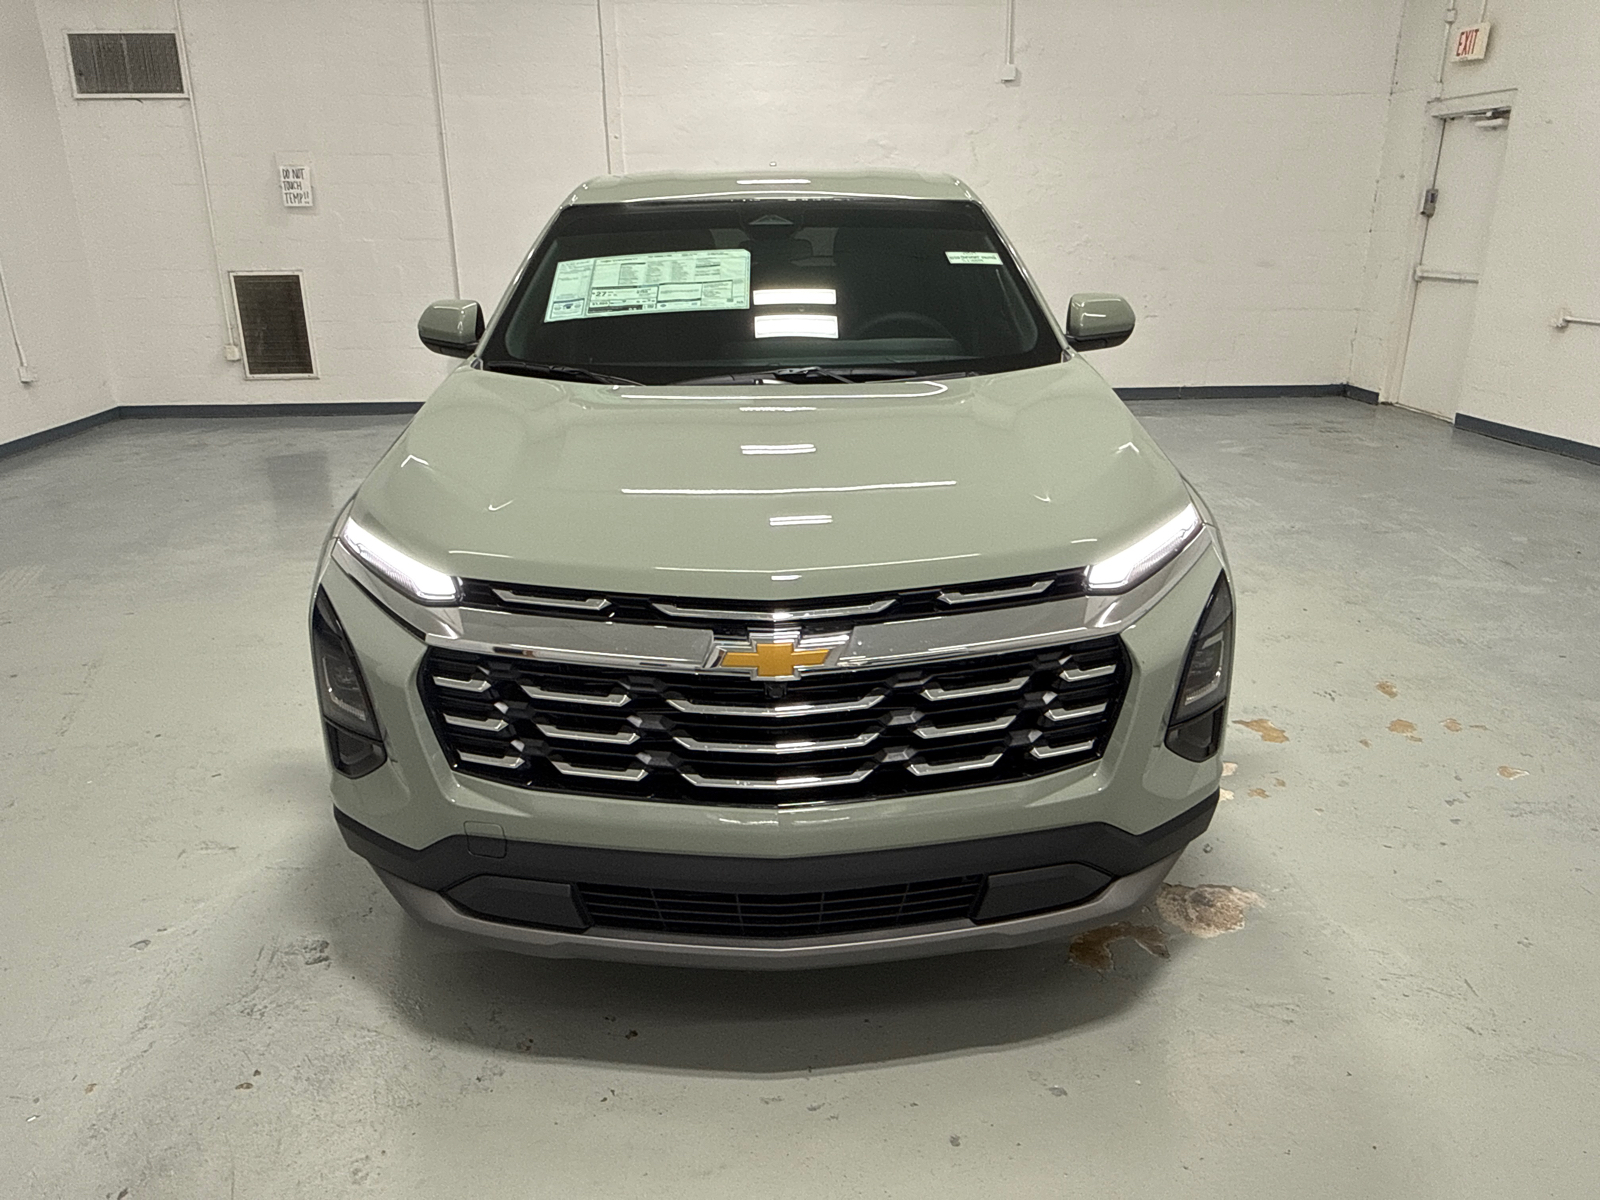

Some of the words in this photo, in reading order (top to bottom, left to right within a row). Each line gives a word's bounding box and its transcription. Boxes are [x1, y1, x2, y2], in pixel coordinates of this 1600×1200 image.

[1455, 28, 1480, 57] EXIT
[282, 168, 290, 180] DO
[292, 168, 305, 180] NOT
[282, 180, 303, 191] TOUCH
